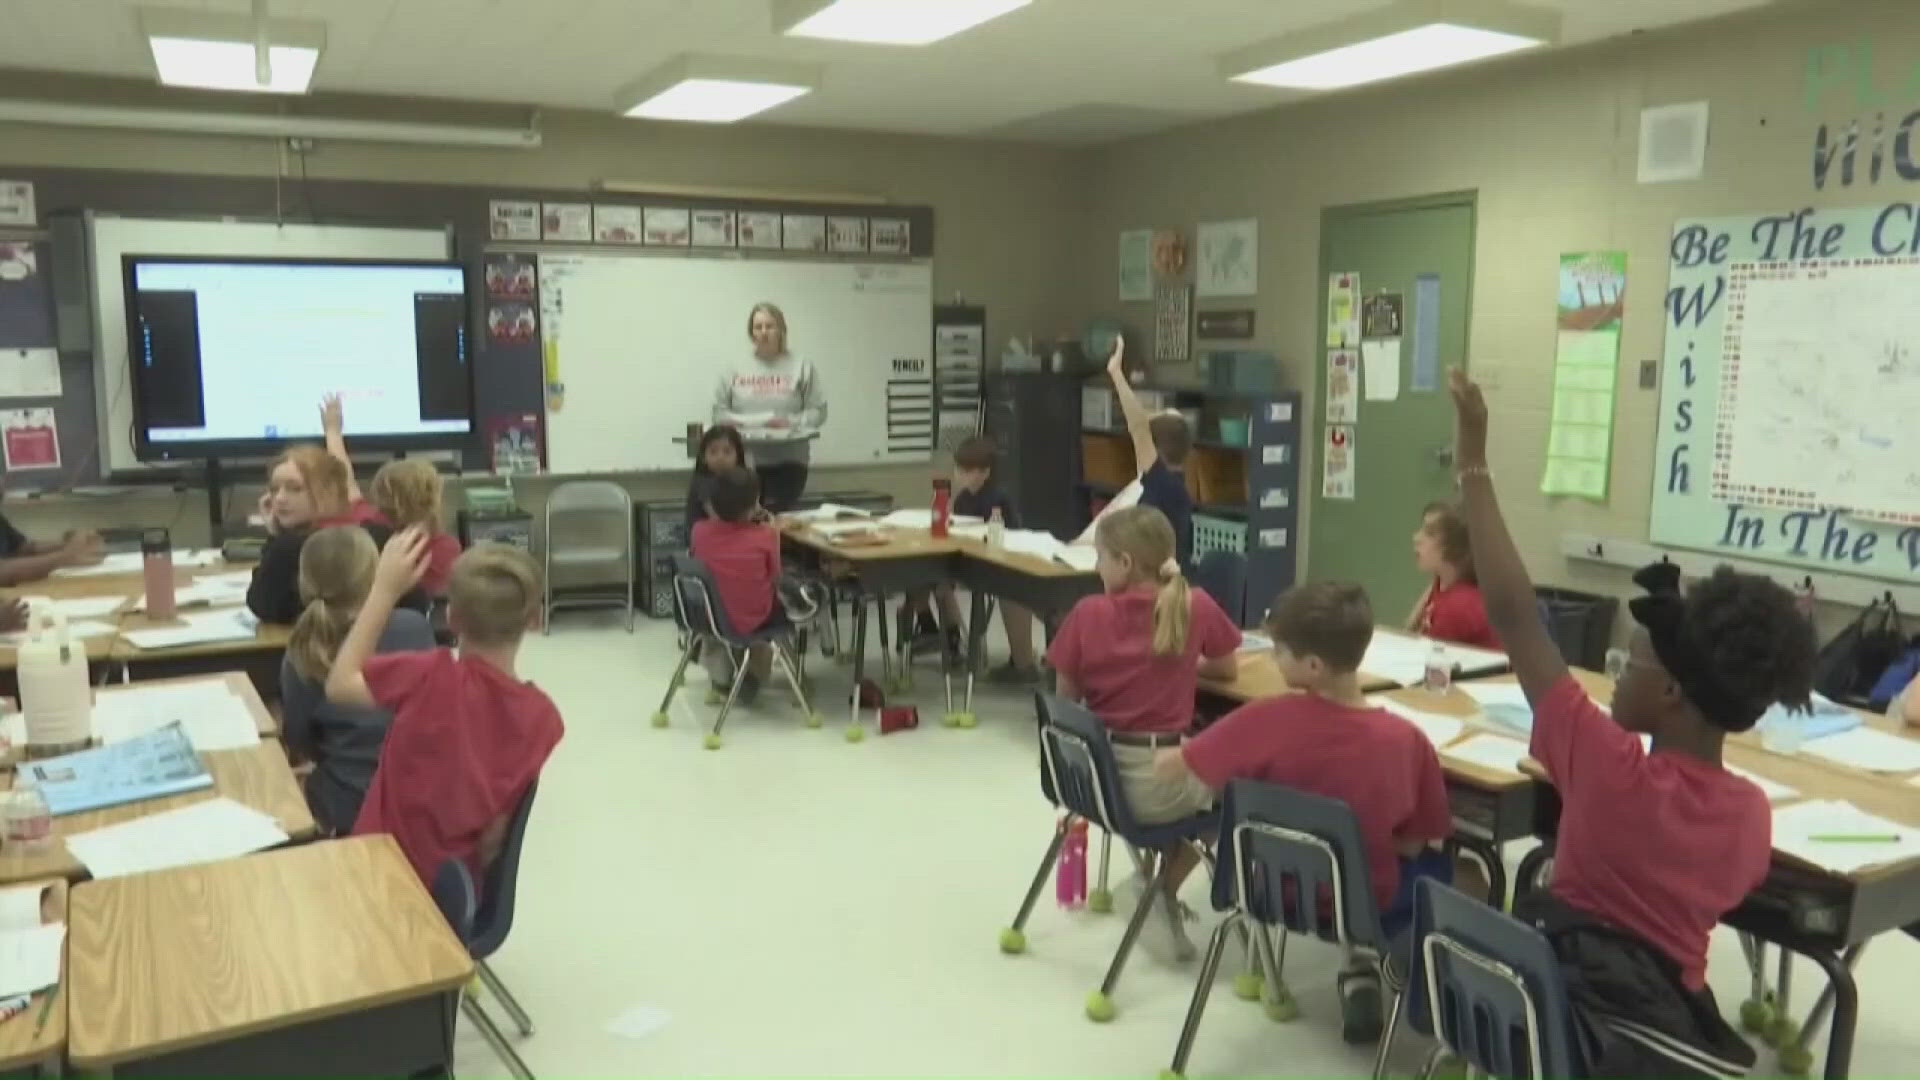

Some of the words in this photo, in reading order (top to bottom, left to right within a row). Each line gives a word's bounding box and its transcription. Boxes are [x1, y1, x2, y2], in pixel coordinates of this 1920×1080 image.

[1671, 224, 1730, 268] Be
[1752, 207, 1845, 260] The
[1664, 275, 1724, 493] Wish
[1717, 504, 1764, 548] In
[1780, 505, 1878, 563] The
